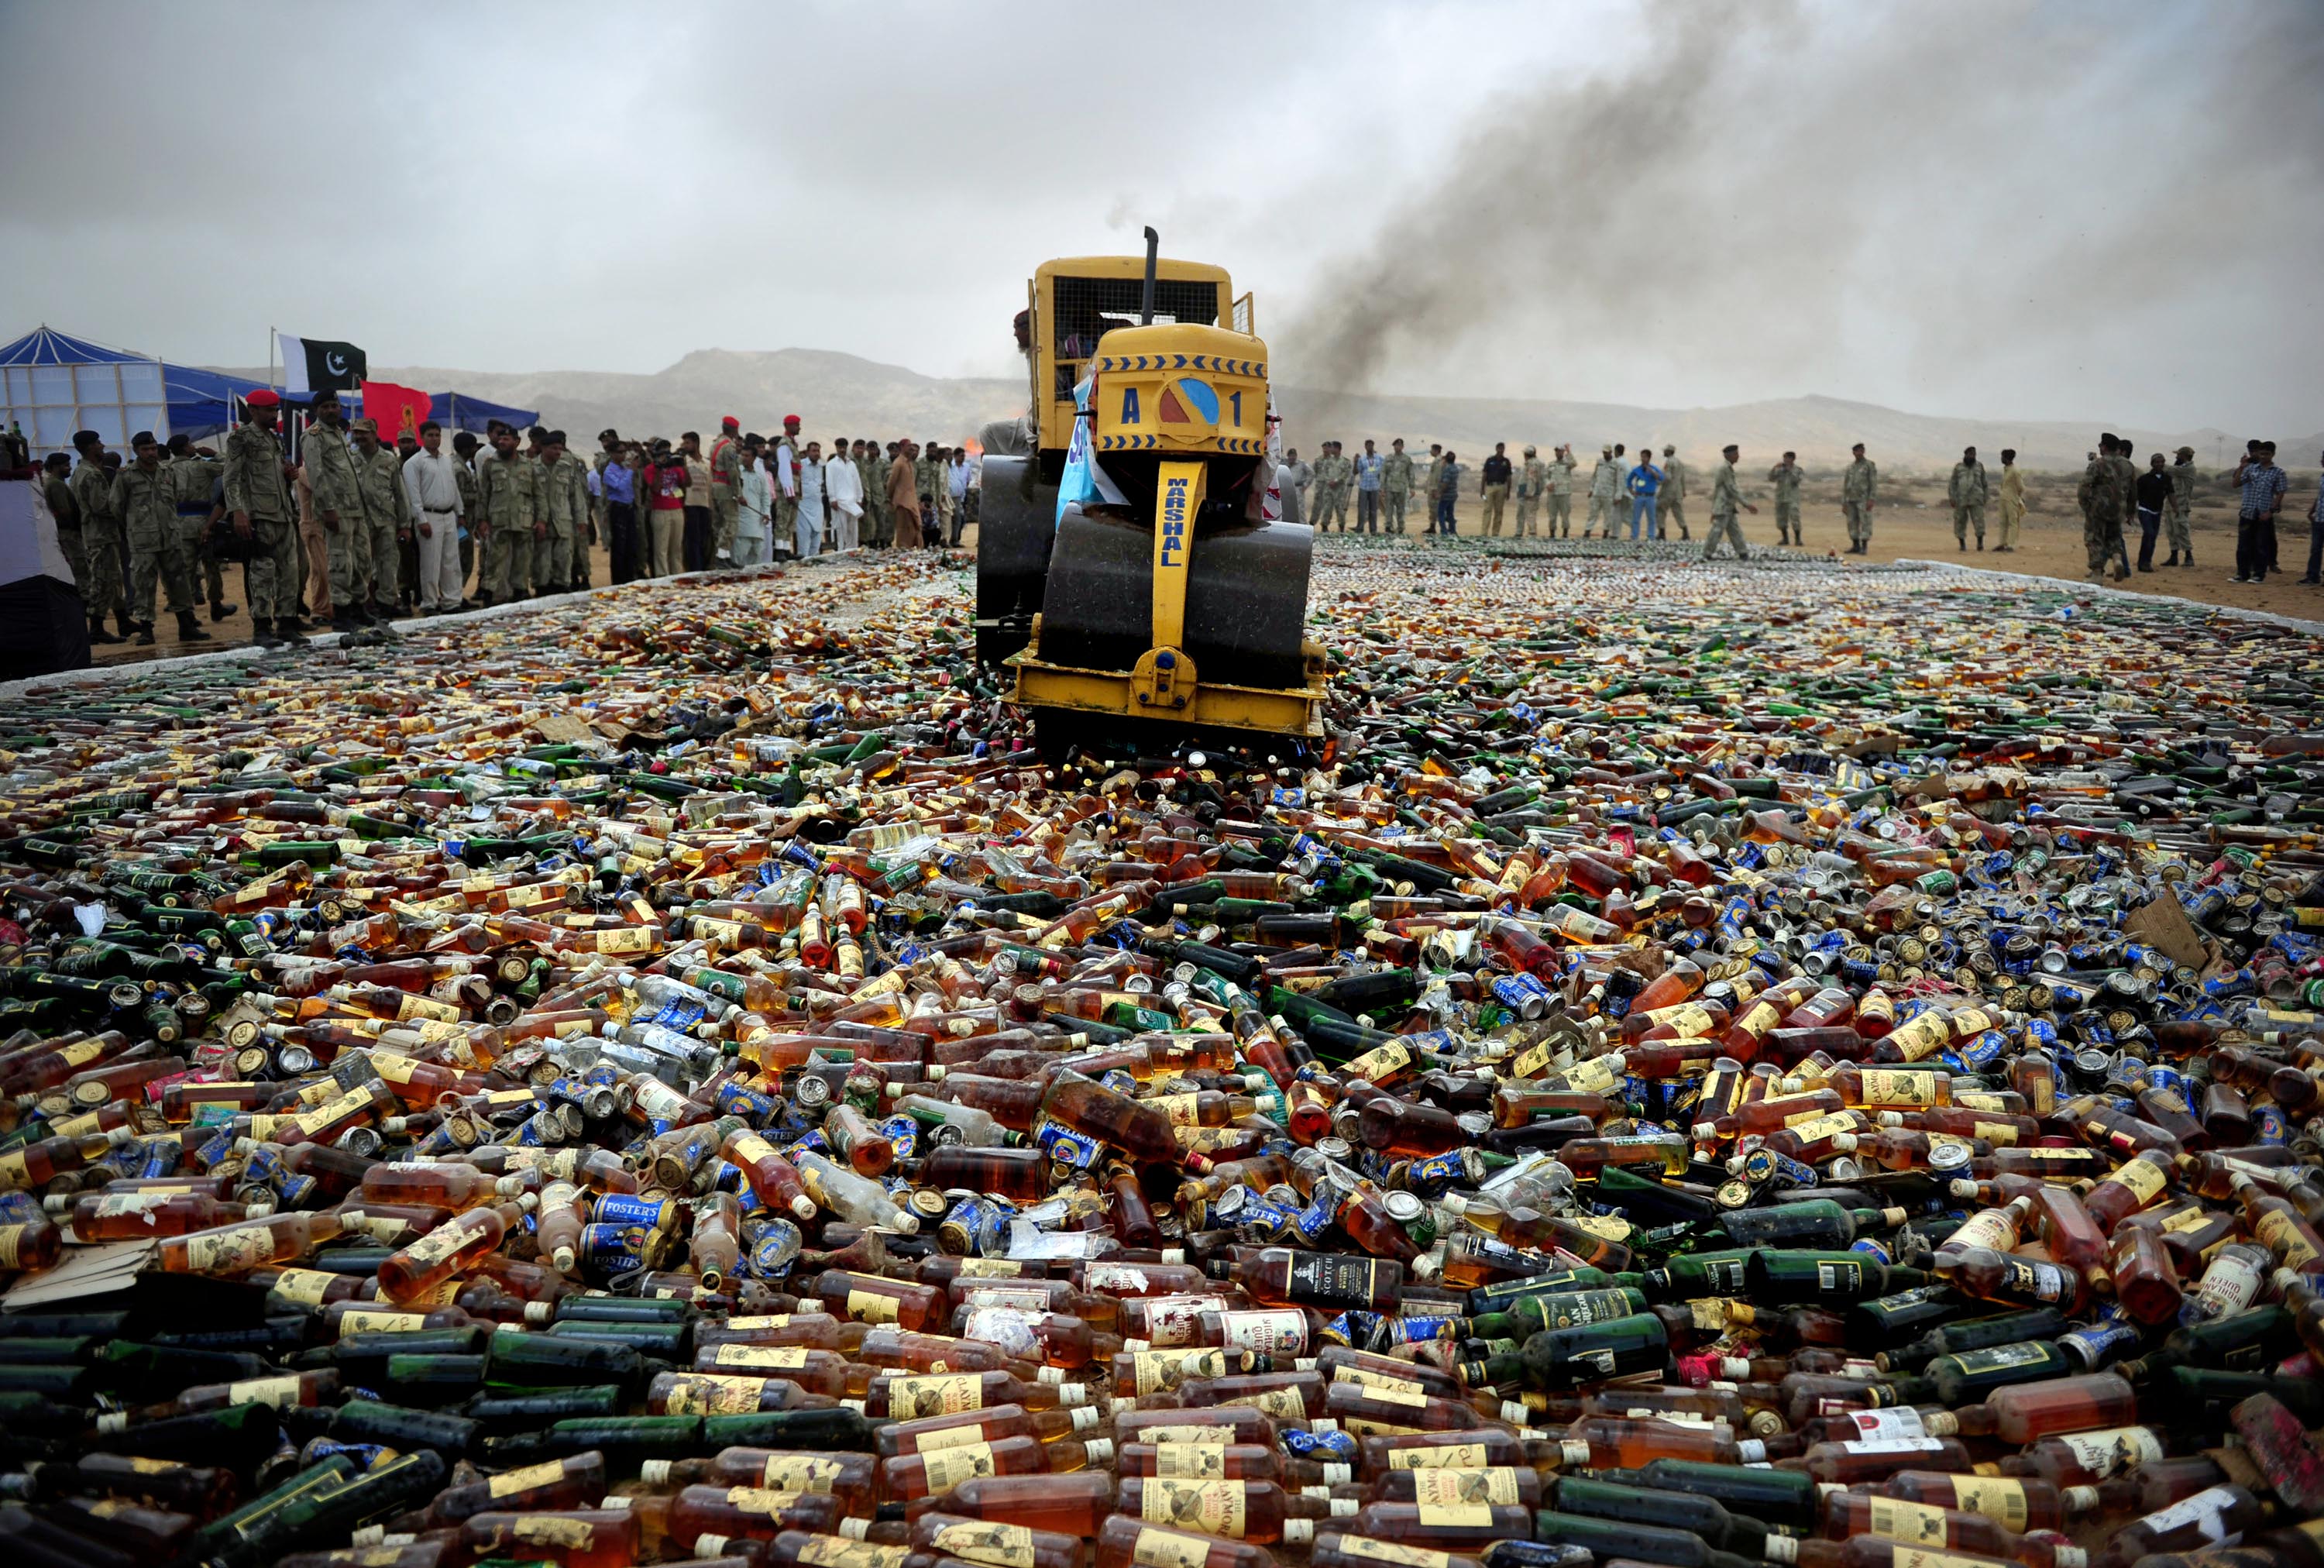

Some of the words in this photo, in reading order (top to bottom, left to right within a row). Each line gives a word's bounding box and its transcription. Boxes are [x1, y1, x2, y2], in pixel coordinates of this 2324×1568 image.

[1121, 388, 1140, 425] A
[1229, 390, 1241, 427] 1
[1159, 478, 1188, 567] MARSHAL
[1047, 1120, 1098, 1148] FOSTER'S
[605, 1202, 658, 1217] FOSTER'S
[1324, 1257, 1333, 1295] SCOTCH
[2209, 1275, 2240, 1293] QUEEN
[1174, 1314, 1184, 1343] QUEEN
[1263, 1318, 1273, 1357] HIGHLAN
[1216, 1480, 1234, 1538] CLAYMORE
